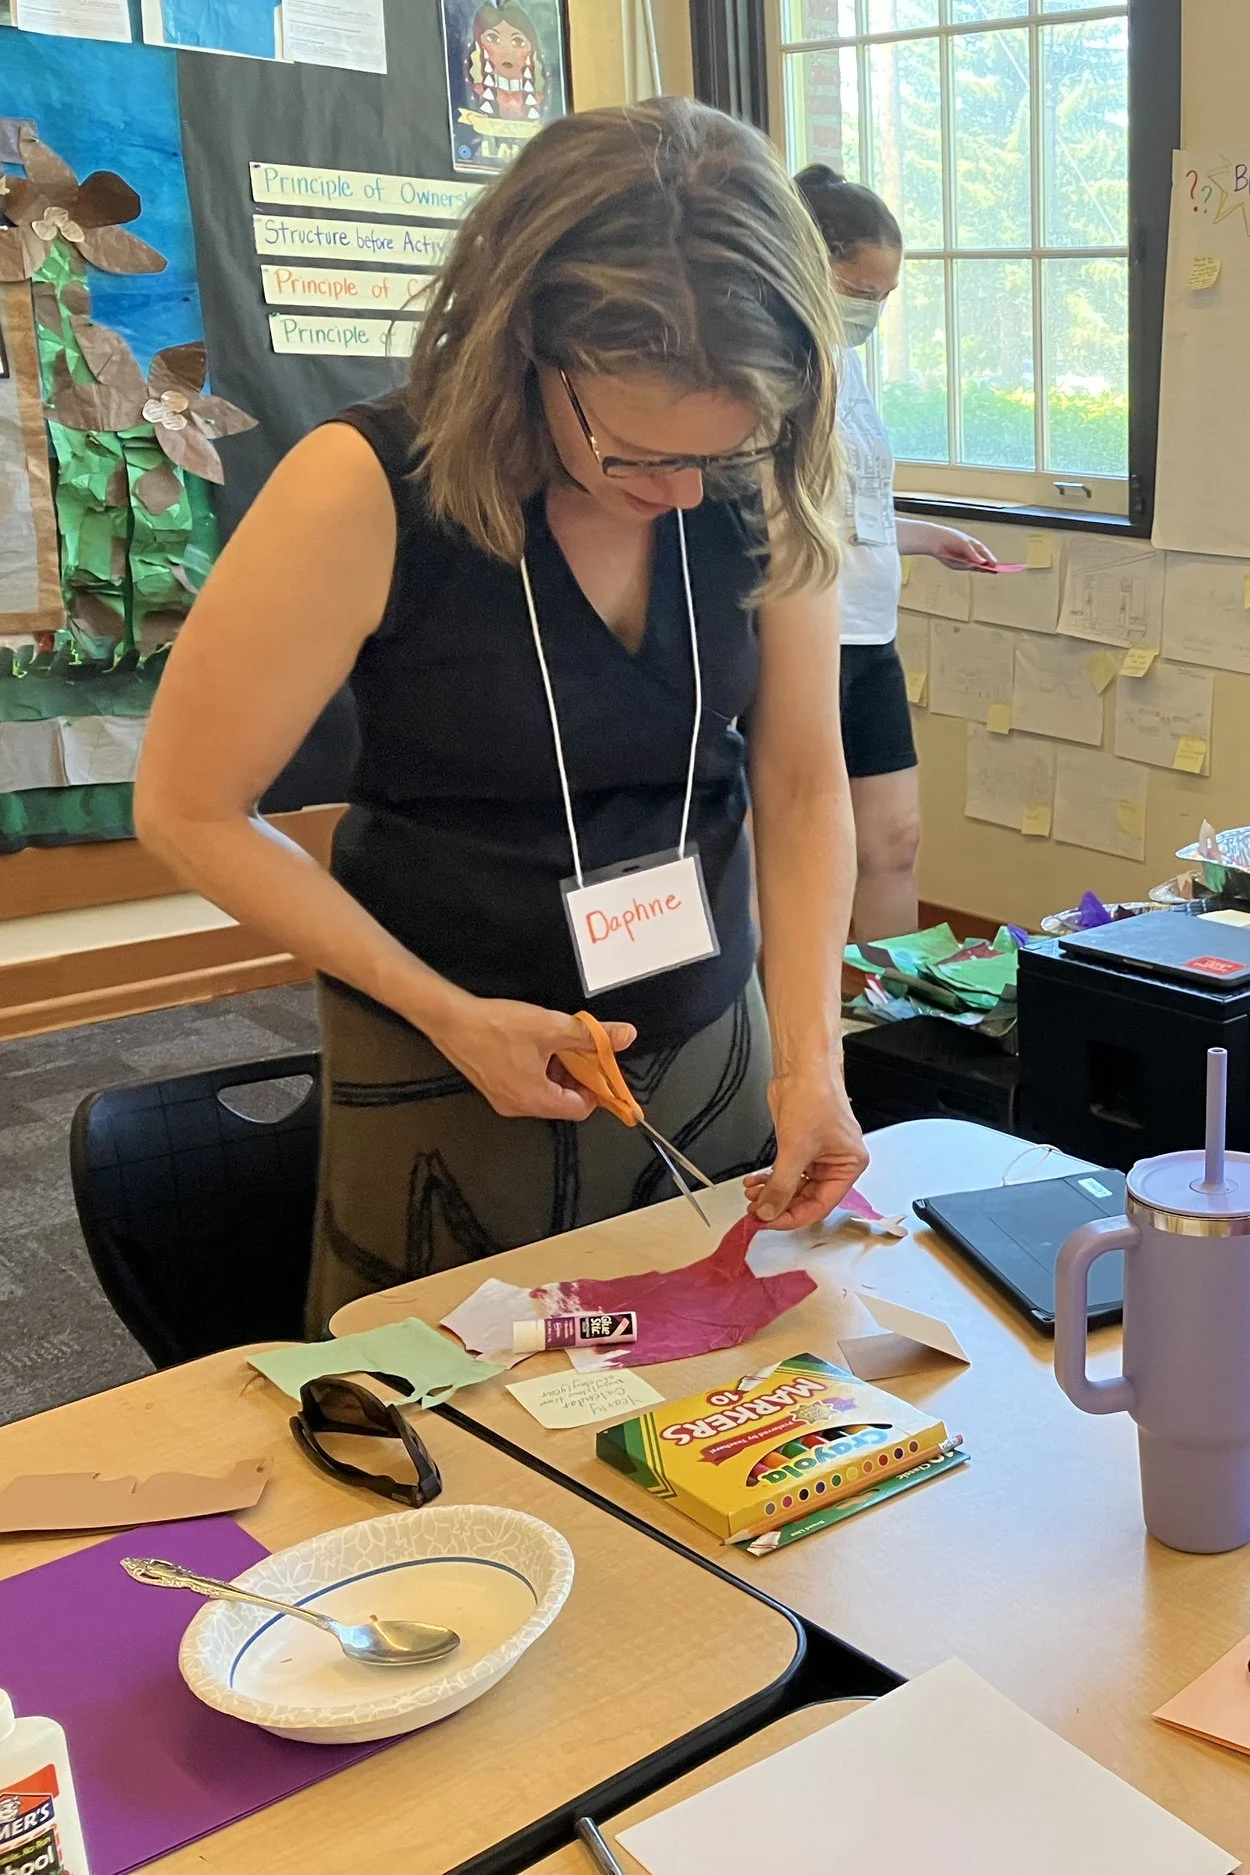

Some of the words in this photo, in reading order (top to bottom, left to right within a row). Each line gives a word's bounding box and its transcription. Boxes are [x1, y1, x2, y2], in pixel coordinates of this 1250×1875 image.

[265, 167, 354, 201] Principle
[364, 178, 385, 201] of
[265, 219, 350, 246] Structure
[356, 227, 394, 253] before
[275, 268, 358, 300] Principle
[371, 277, 390, 298] of
[281, 318, 369, 348] Principle
[586, 894, 682, 944] Daphne
[600, 1316, 612, 1335] Glue
[660, 1377, 827, 1446] MARKERS
[711, 1391, 738, 1405] 10
[758, 1421, 794, 1437] Preferred
[762, 1428, 889, 1485] Crayola
[896, 1463, 931, 1480] Classic
